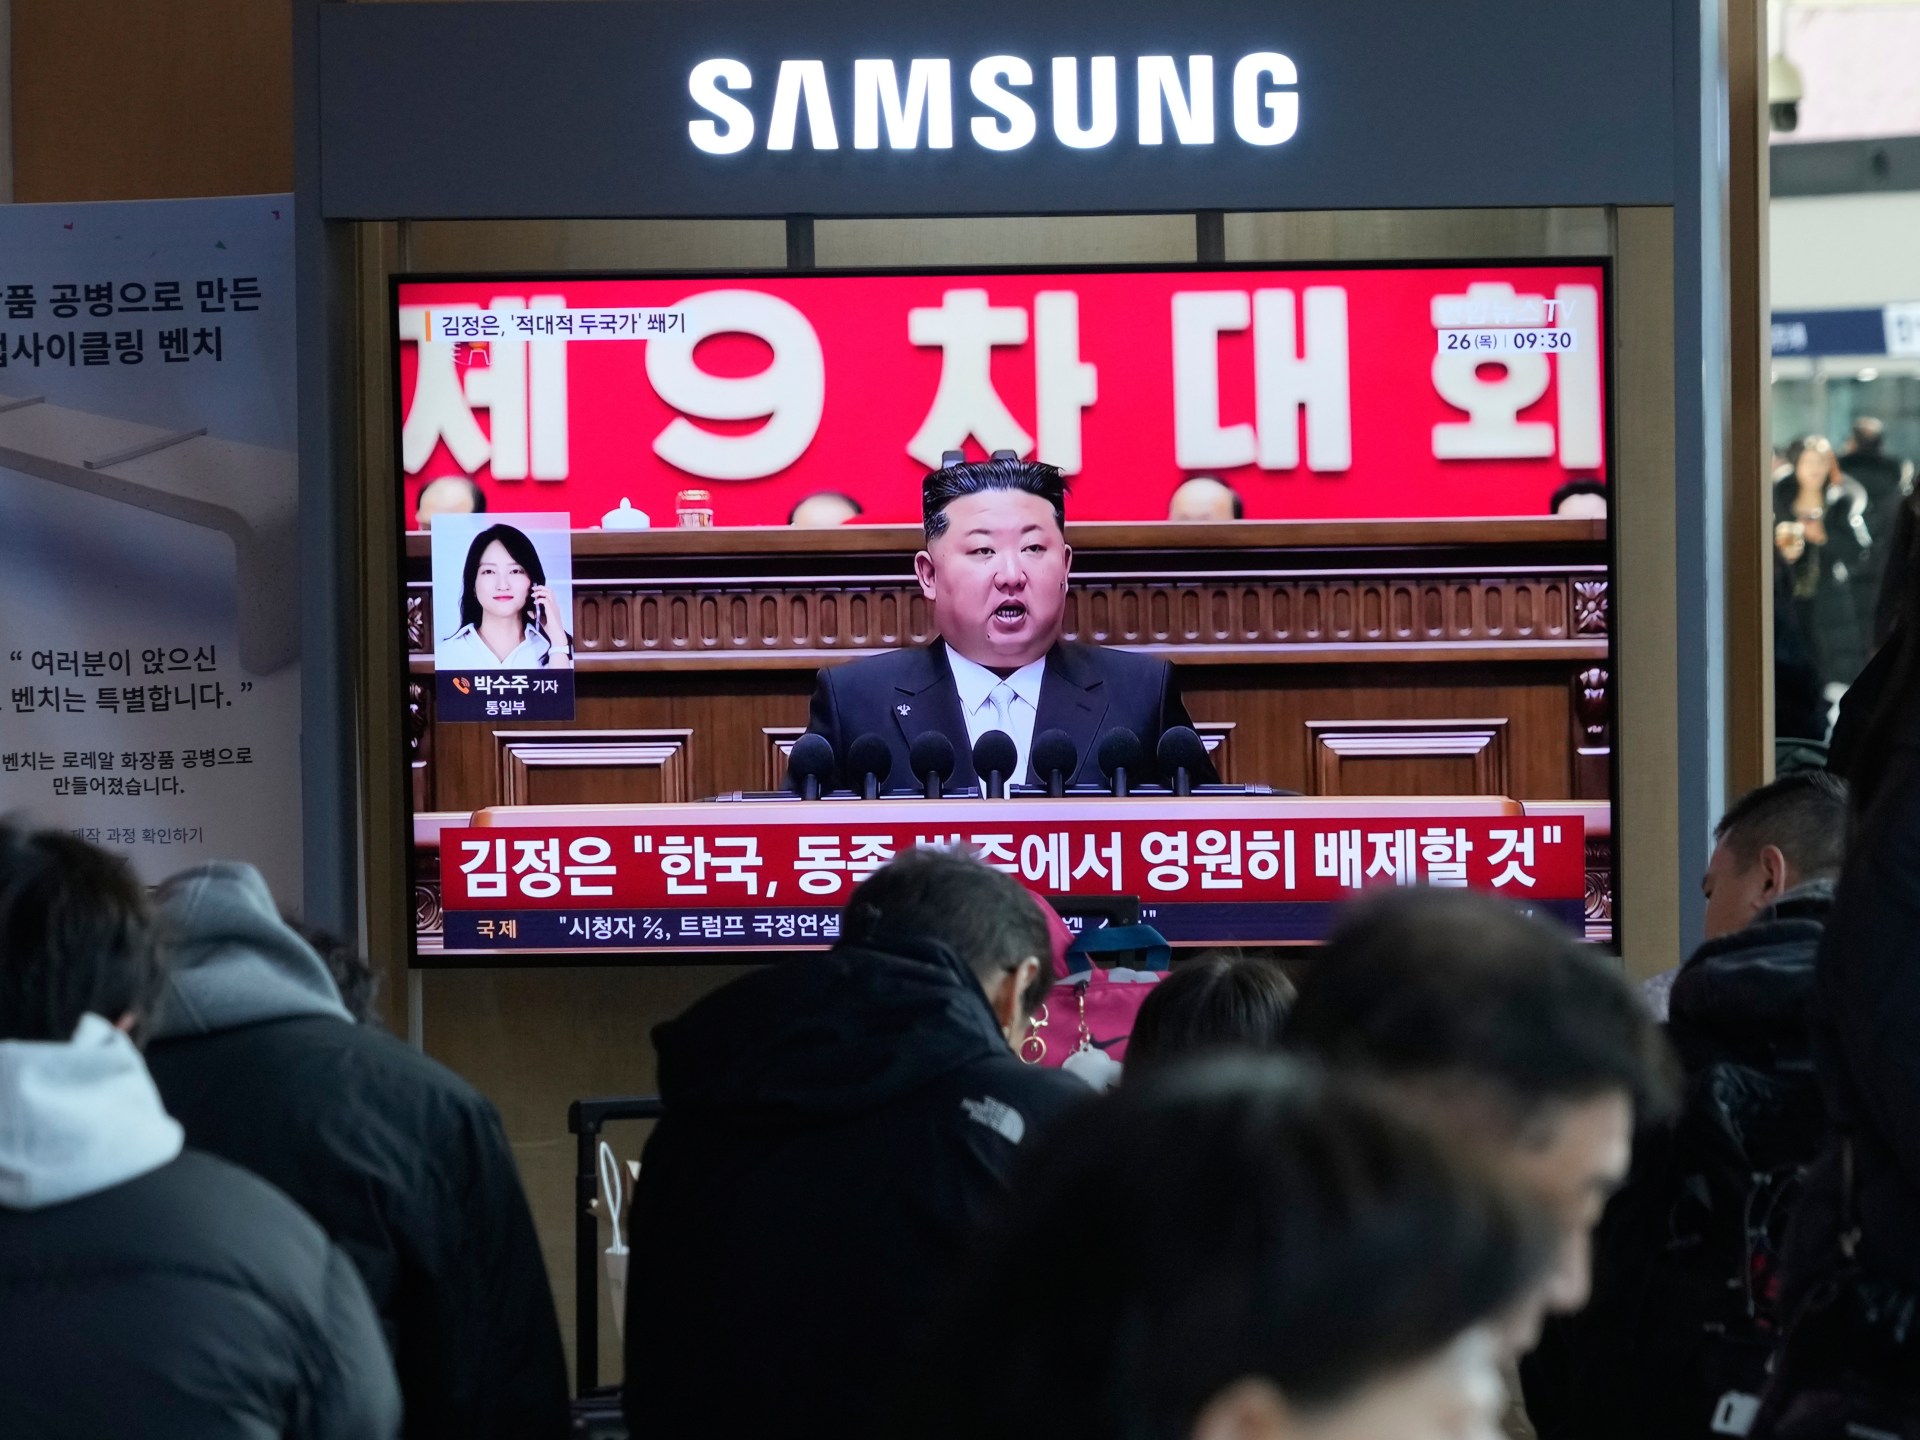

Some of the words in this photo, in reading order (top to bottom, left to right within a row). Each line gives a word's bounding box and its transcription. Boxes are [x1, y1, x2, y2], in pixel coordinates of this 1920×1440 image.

[688, 52, 1300, 155] SAMSUNG
[0, 283, 37, 320] 품
[49, 281, 185, 319] 공병으로
[196, 276, 262, 314] 만든
[441, 314, 506, 338] 김정은,
[646, 311, 687, 334] 쐐기
[0, 328, 144, 369] 사이클링
[158, 326, 223, 363] 벤치
[1513, 332, 1572, 349] 09:30
[141, 645, 217, 675] 앉으신
[474, 675, 530, 695] 박수주
[532, 679, 559, 694] 기자
[11, 685, 87, 713] 벤치는
[485, 700, 527, 716] 통일부
[2, 751, 56, 771] 벤치는
[62, 751, 115, 770] 로레알
[121, 750, 175, 770] 화장품
[181, 747, 253, 769] 공병으로
[53, 776, 186, 796] 만들어졌습니다.
[106, 828, 136, 845] 과정
[141, 827, 204, 845] 확인하기
[459, 836, 617, 898] 김정은
[634, 834, 778, 898] "한국,
[1140, 829, 1296, 891] 영원히
[1314, 827, 1473, 889] 배제할
[1487, 825, 1562, 888] 것"
[559, 915, 636, 940] "시청자
[679, 914, 746, 938] 트럼프
[752, 913, 841, 938] 국정연설
